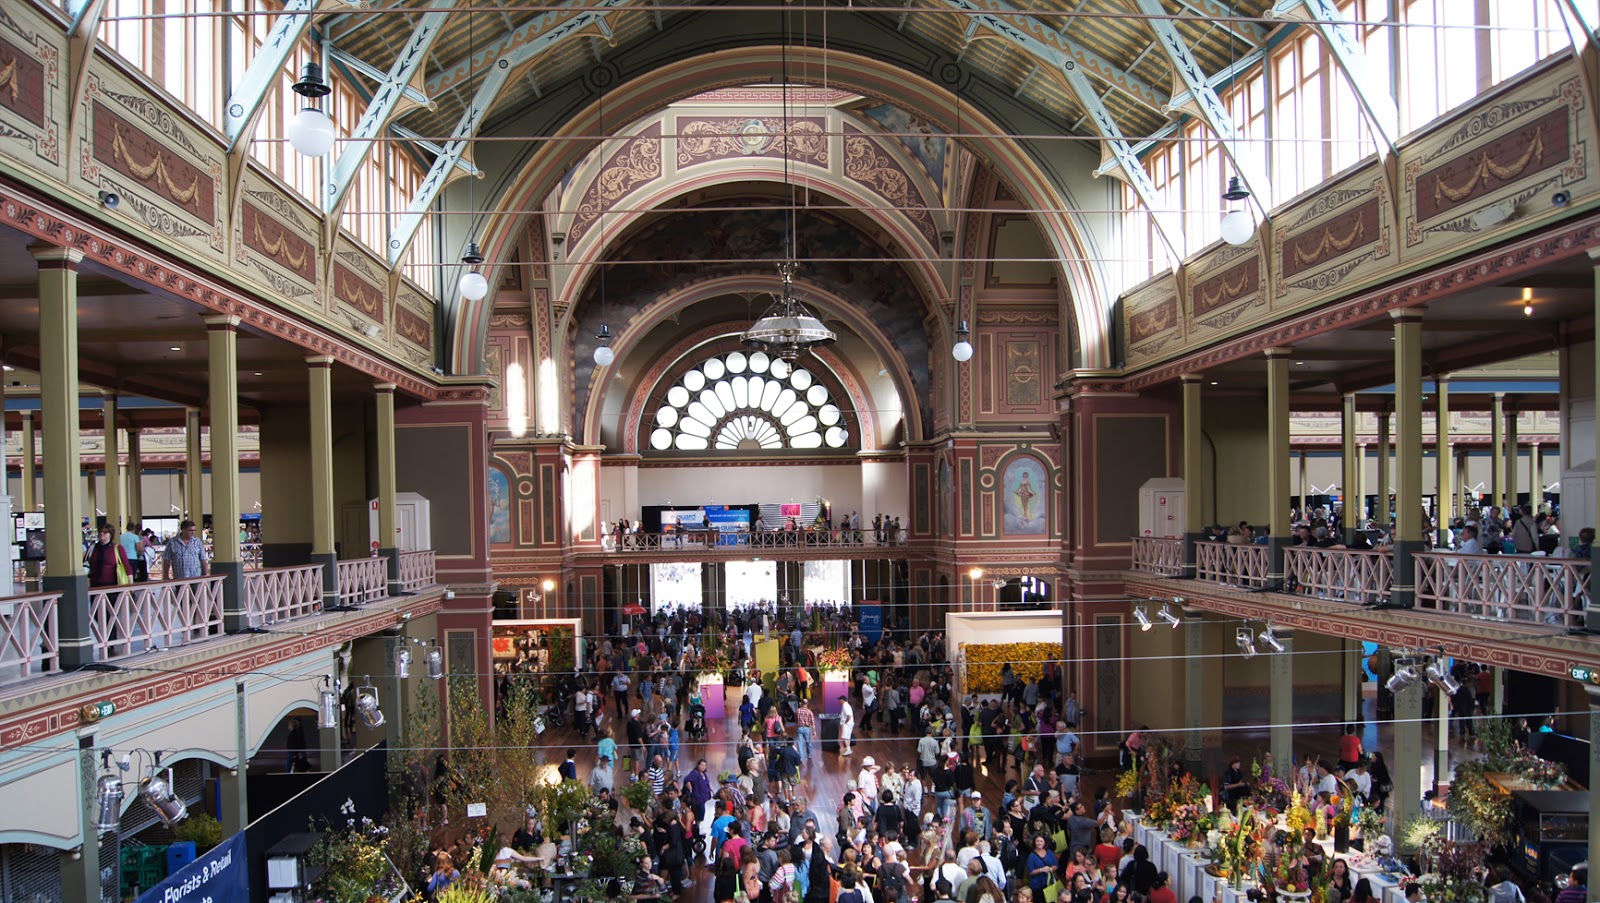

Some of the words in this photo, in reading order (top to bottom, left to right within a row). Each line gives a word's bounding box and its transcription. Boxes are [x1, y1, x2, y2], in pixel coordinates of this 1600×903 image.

[165, 875, 202, 903] Florists
[202, 866, 209, 883] &
[210, 848, 232, 878] Retail
